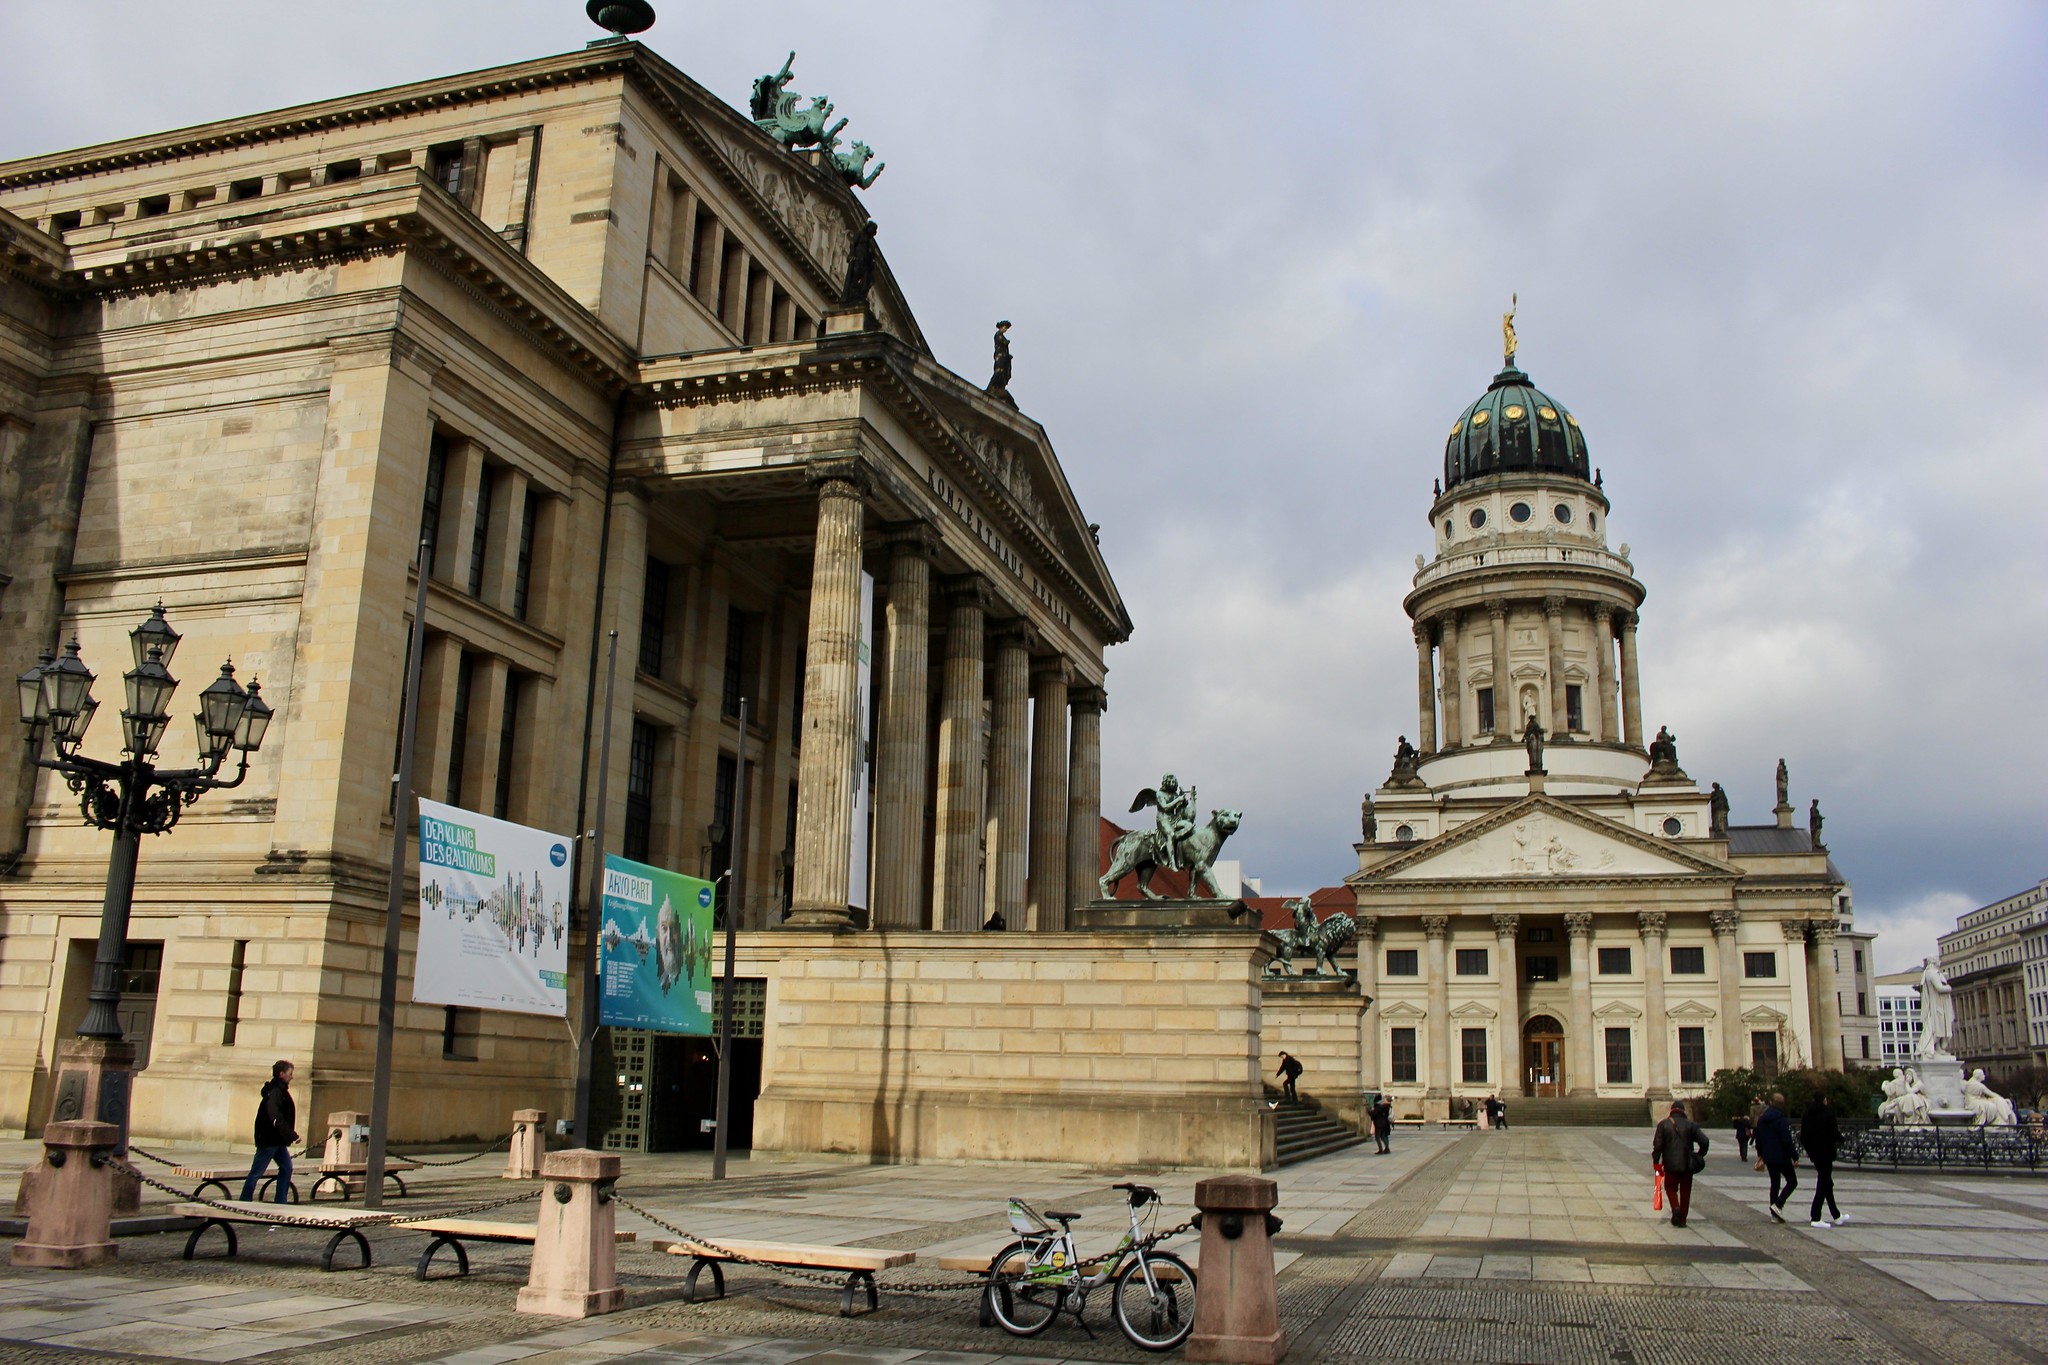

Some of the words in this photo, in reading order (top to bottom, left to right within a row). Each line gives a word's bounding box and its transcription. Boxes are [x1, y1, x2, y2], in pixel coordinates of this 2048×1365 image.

[927, 466, 1025, 582] KONZERTHAUS
[1032, 577, 1072, 630] BERLIN
[425, 819, 445, 842] DER
[445, 824, 474, 850] KLANG
[426, 841, 445, 864] DES
[445, 846, 494, 875] BALTIKUMS
